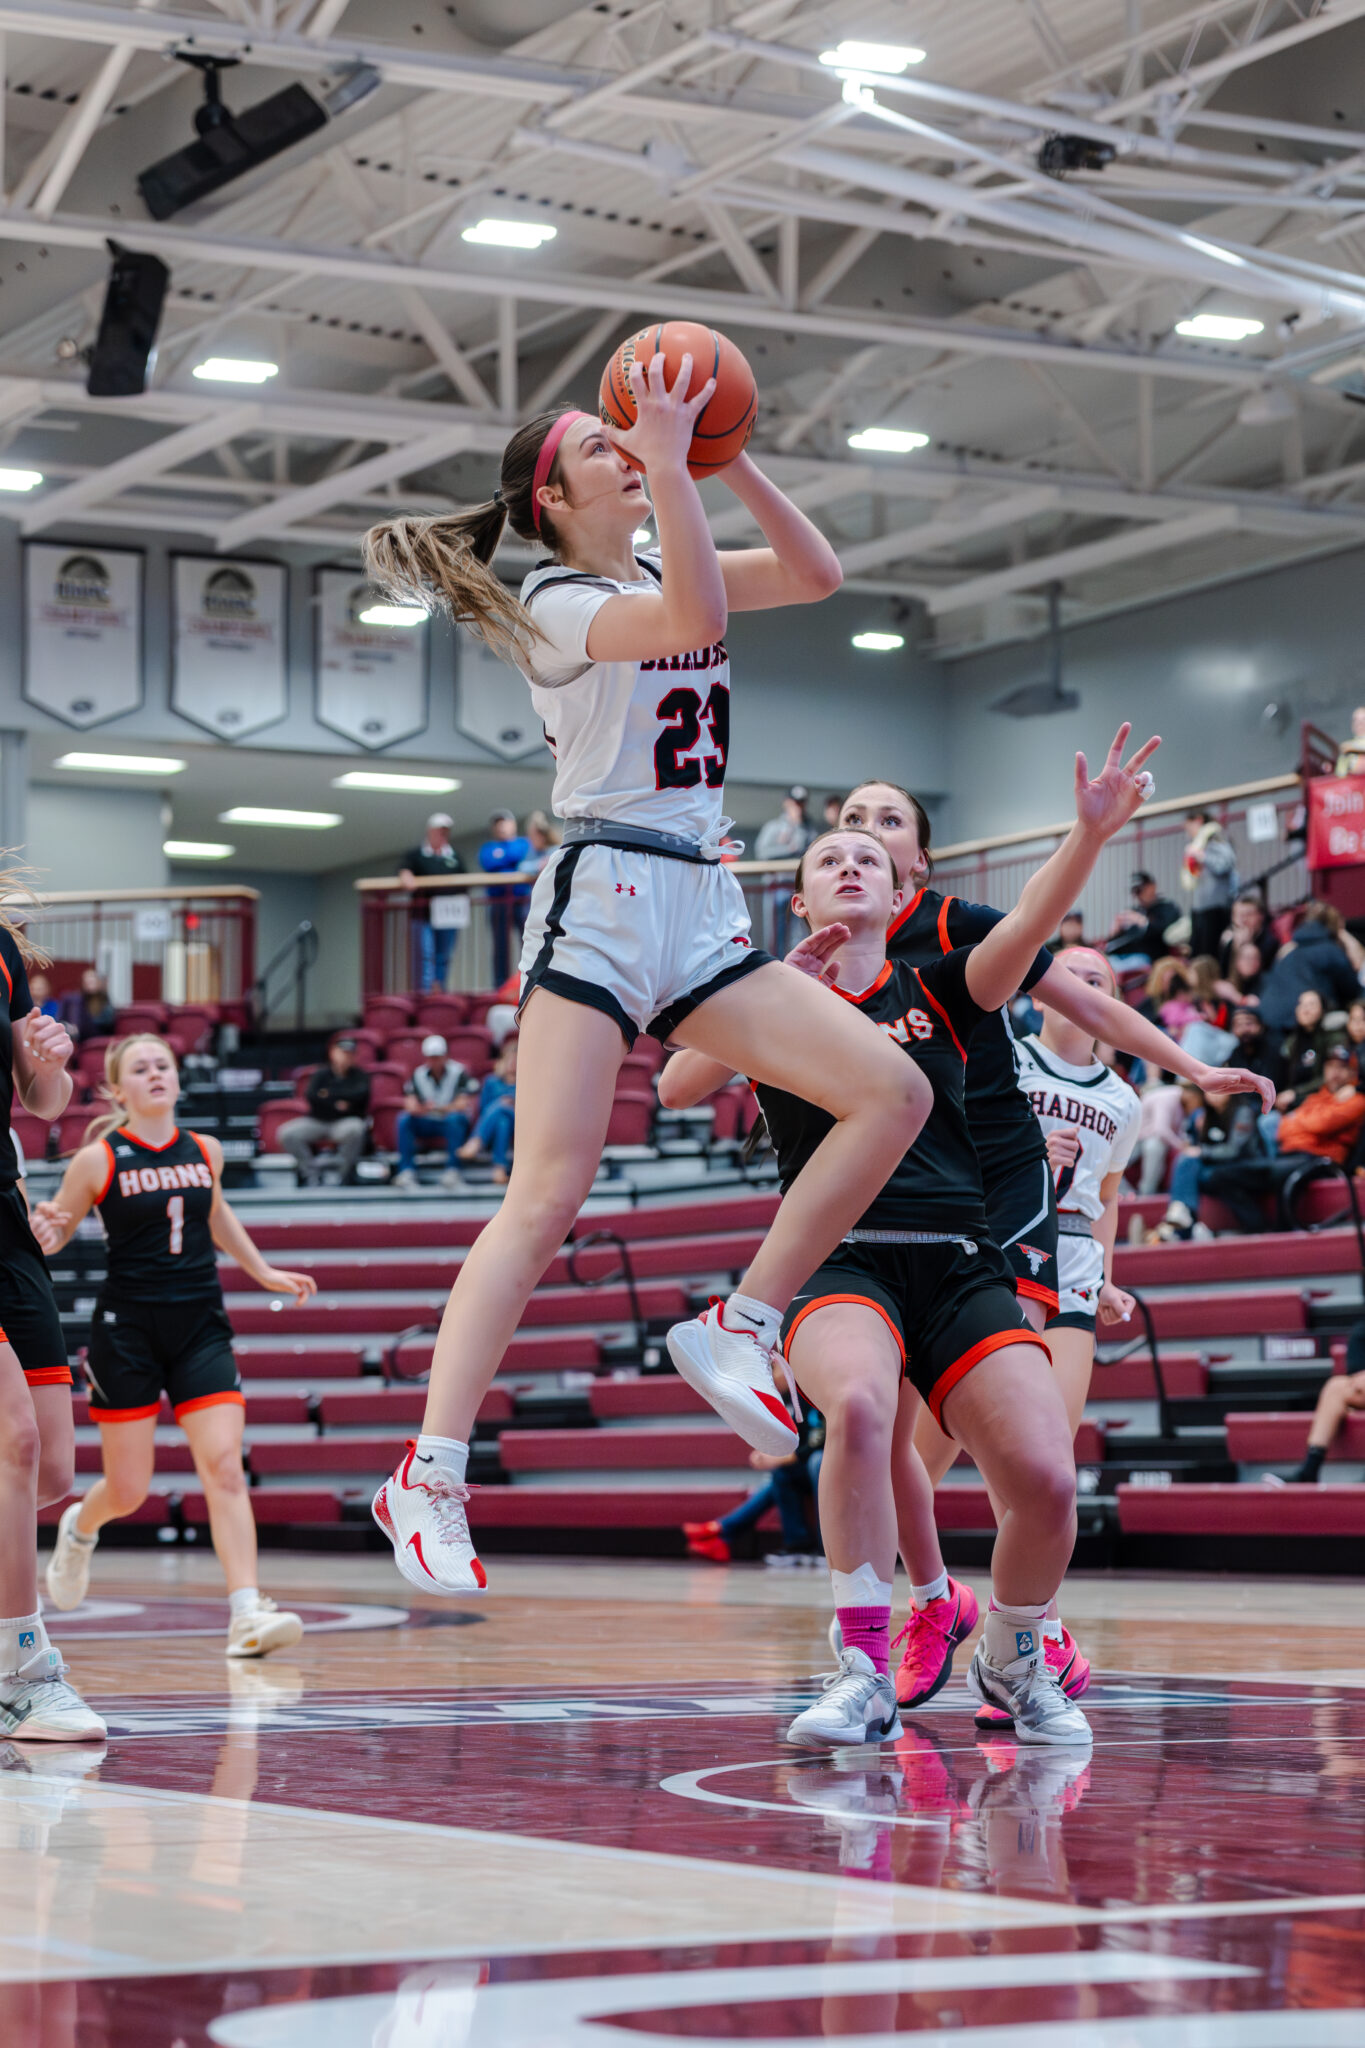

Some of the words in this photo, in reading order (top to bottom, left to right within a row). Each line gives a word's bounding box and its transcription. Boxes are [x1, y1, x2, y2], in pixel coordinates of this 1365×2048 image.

[655, 681, 730, 791] 23
[118, 1163, 213, 1198] HORNS
[166, 1195, 185, 1255] 1
